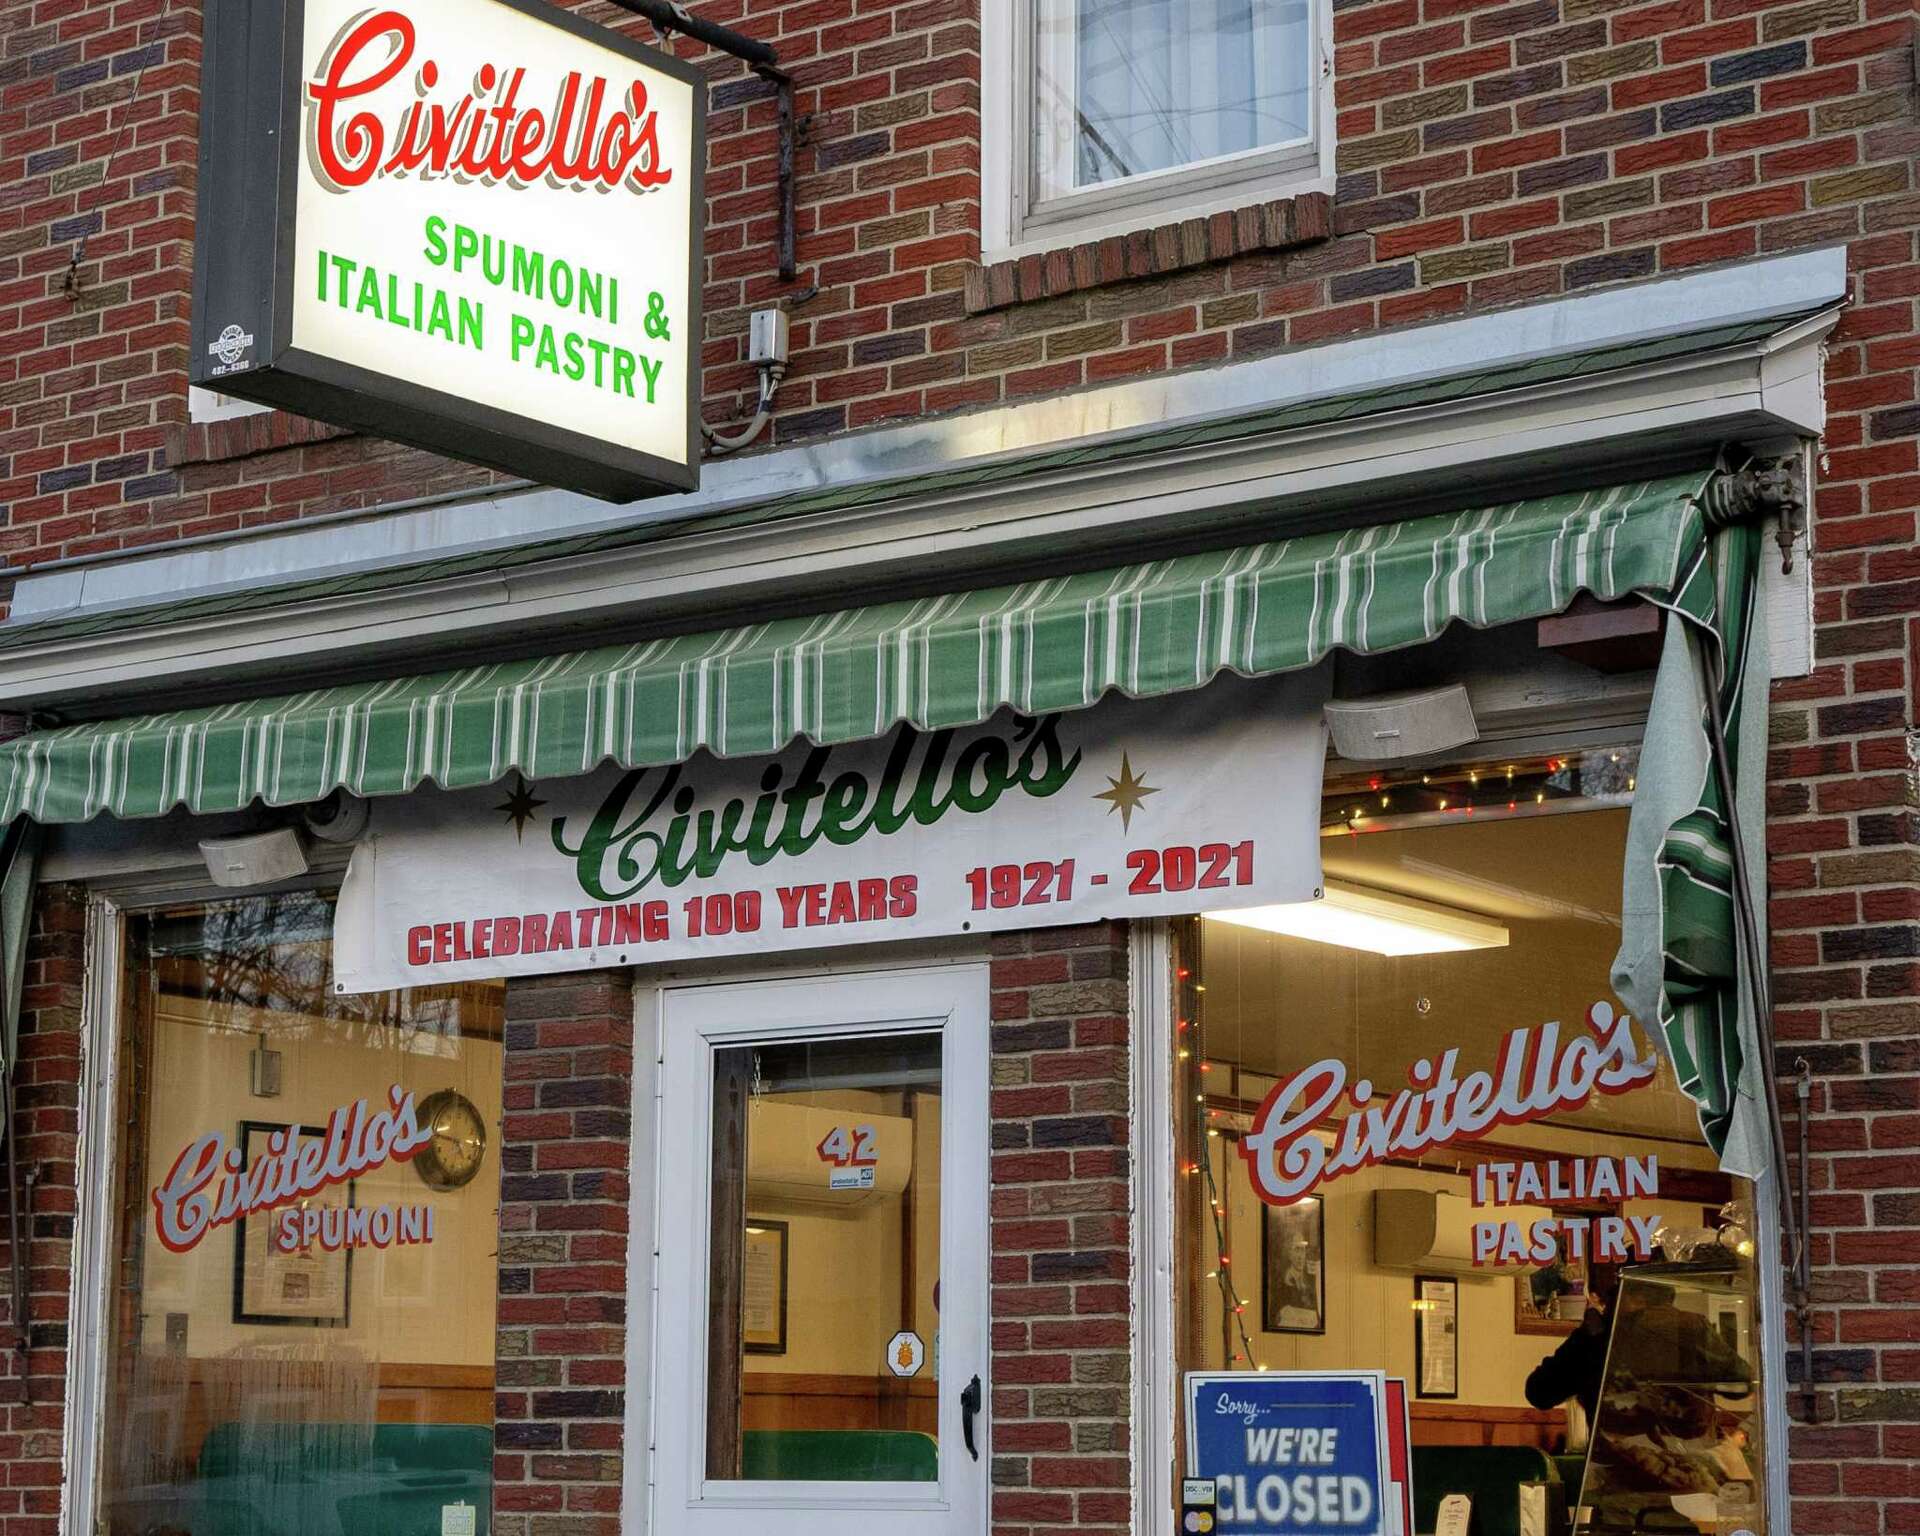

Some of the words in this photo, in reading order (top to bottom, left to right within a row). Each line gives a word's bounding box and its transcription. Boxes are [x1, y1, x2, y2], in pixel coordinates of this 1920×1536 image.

[304, 8, 672, 194] Civitello's
[424, 215, 618, 325] SPUMONI
[643, 291, 672, 342] &
[317, 250, 484, 351] ITALIAN
[511, 313, 663, 404] PASTRY
[551, 712, 1081, 901] Civitello's
[408, 900, 669, 966] CELEBRATING
[683, 890, 761, 938] 100
[776, 874, 918, 929] YEARS
[966, 858, 1075, 911] 1921
[1091, 874, 1108, 885] -
[1126, 840, 1254, 896] 2021
[816, 1124, 880, 1167] 42
[1240, 1002, 1656, 1206] Civitello's
[153, 1084, 436, 1253] Civitello's
[1471, 1155, 1659, 1207] ITALIAN
[277, 1205, 434, 1253] SPUMONI
[1472, 1215, 1662, 1266] PASTRY
[1215, 1392, 1271, 1424] Sorry...
[1245, 1428, 1338, 1465] WE'RE
[1216, 1474, 1373, 1525] CLOSED
